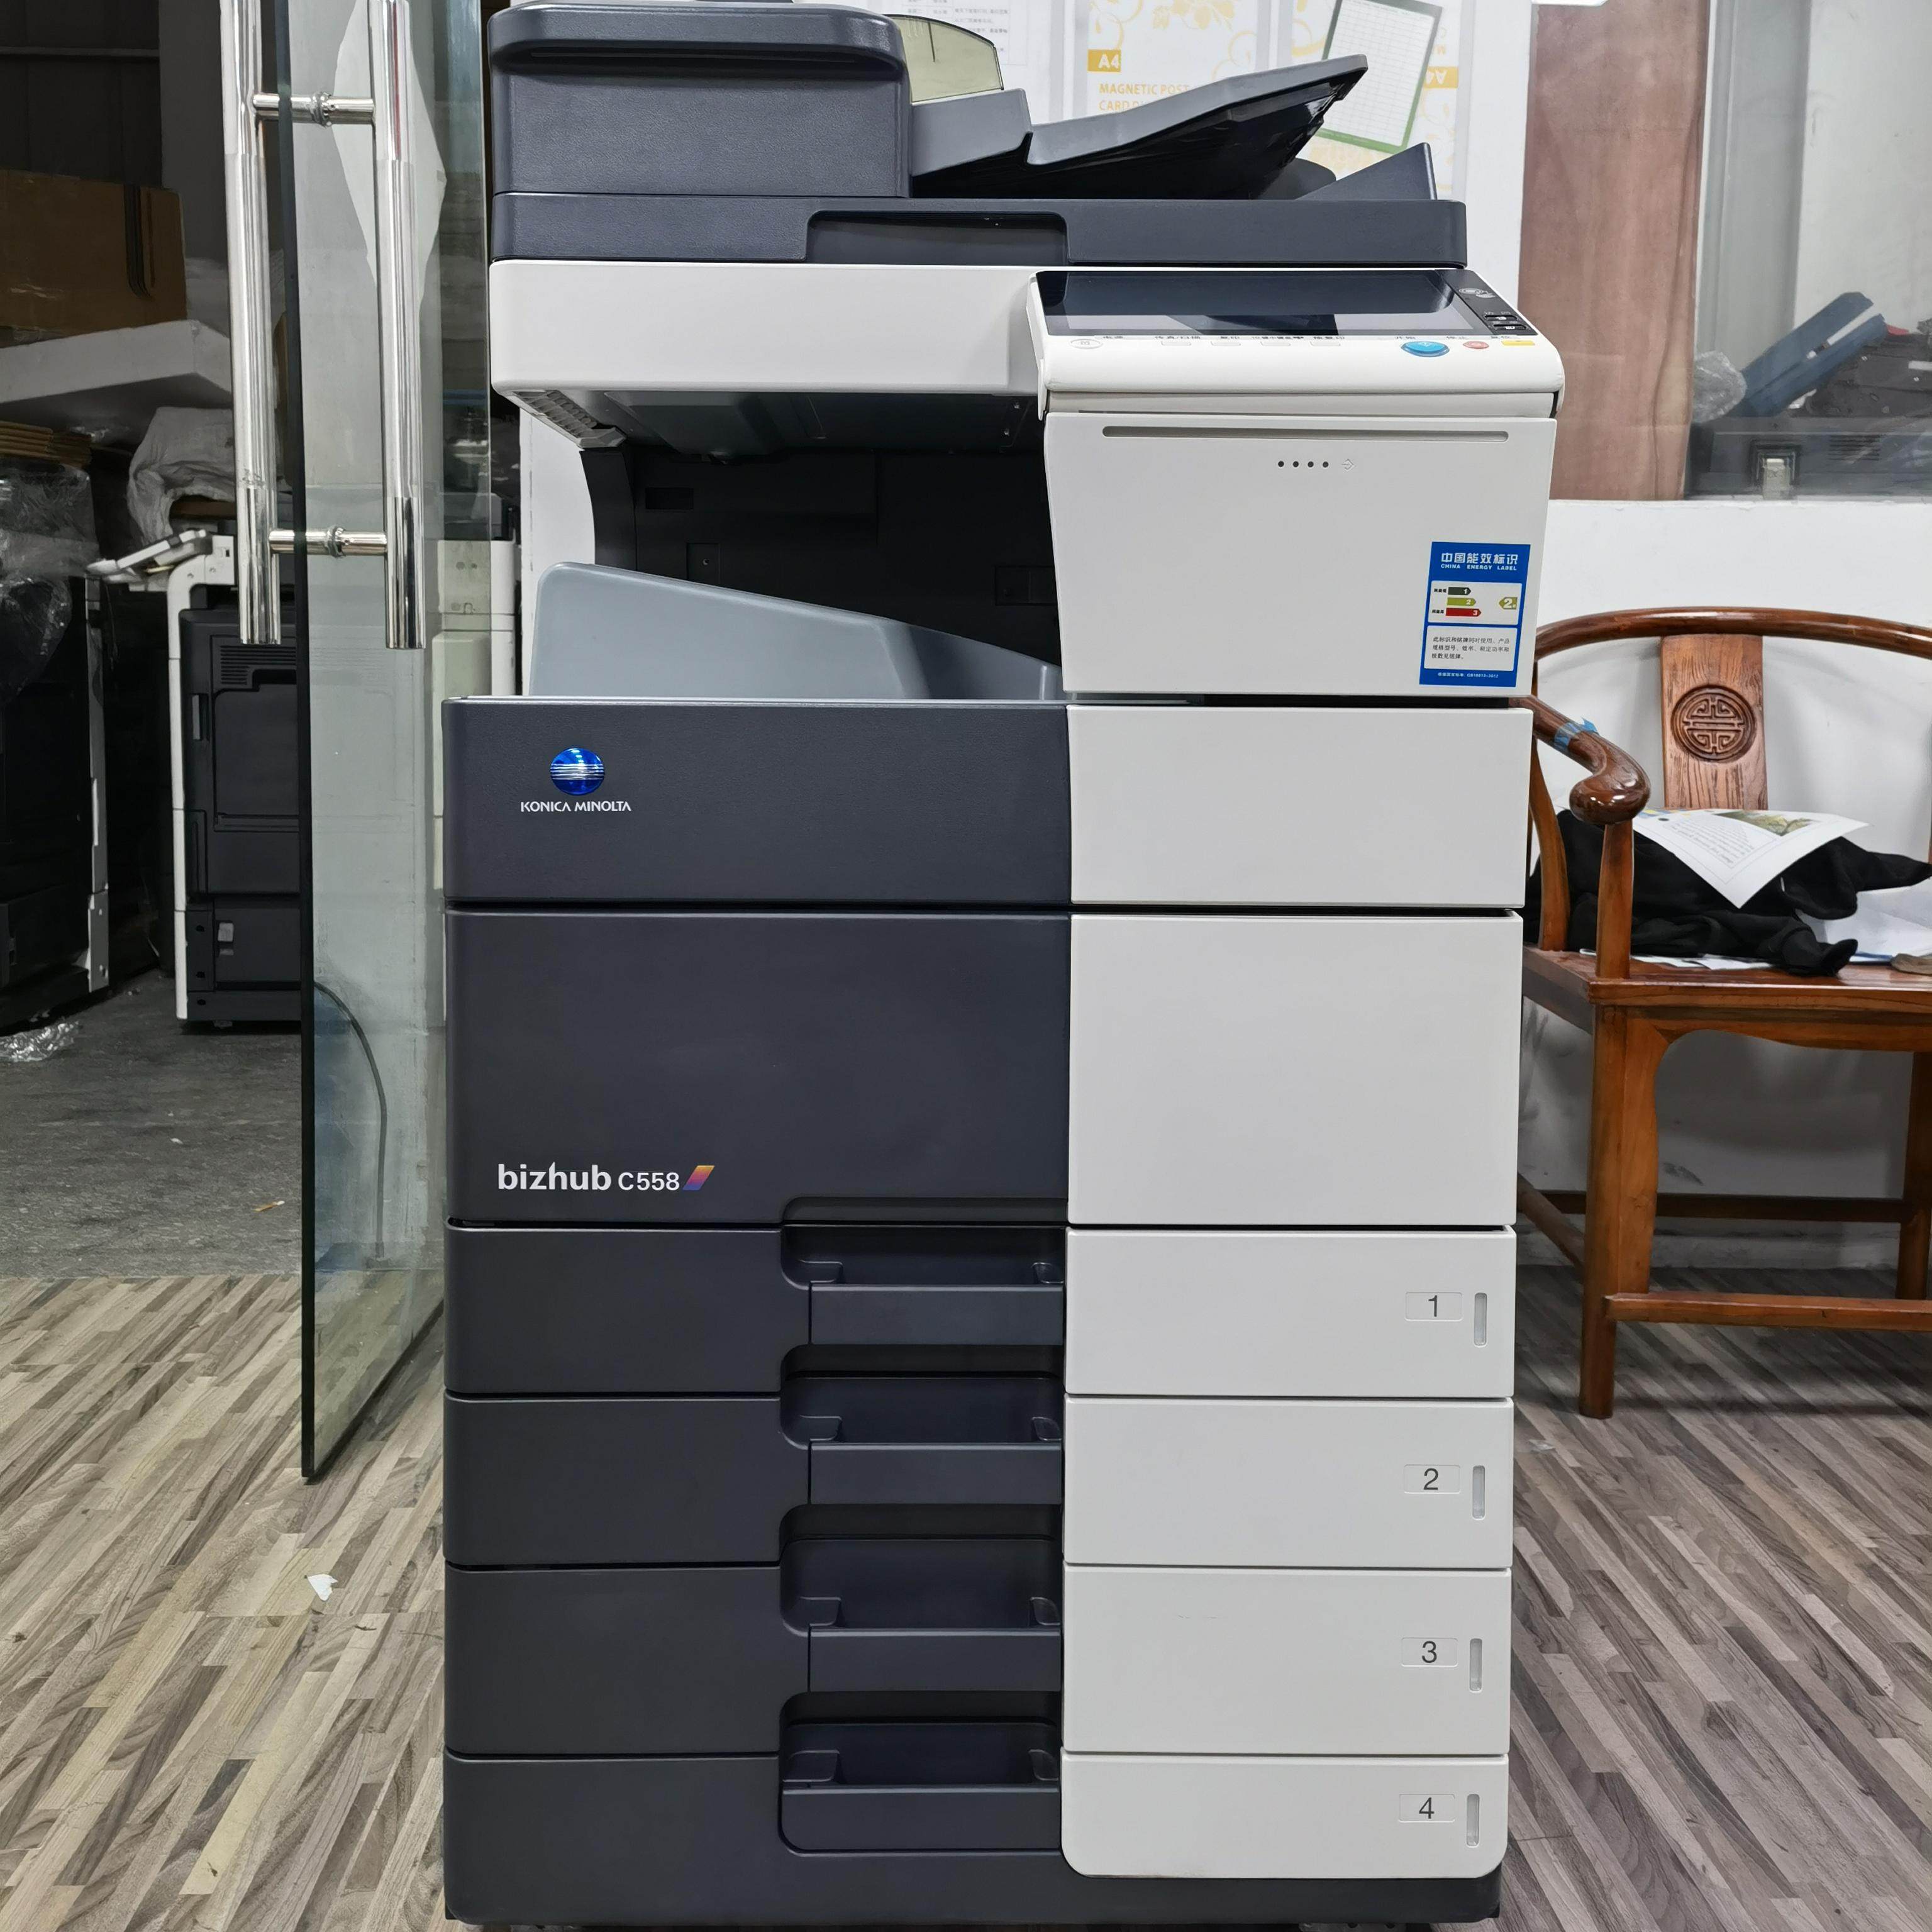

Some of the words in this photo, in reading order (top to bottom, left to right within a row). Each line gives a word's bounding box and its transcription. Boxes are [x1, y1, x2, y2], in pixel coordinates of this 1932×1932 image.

[1099, 54, 1119, 69] A4
[1099, 83, 1158, 95] MAGNETIC
[1441, 552, 1519, 565] 中国能效标识
[520, 801, 572, 812] KONICA
[574, 801, 631, 812] MINOLTA
[497, 1162, 612, 1191] bizhub
[618, 1172, 680, 1191] C558
[1428, 1294, 1438, 1318] 1
[1423, 1467, 1439, 1491] 2
[1421, 1640, 1438, 1664] 3
[1418, 1797, 1435, 1819] 4
